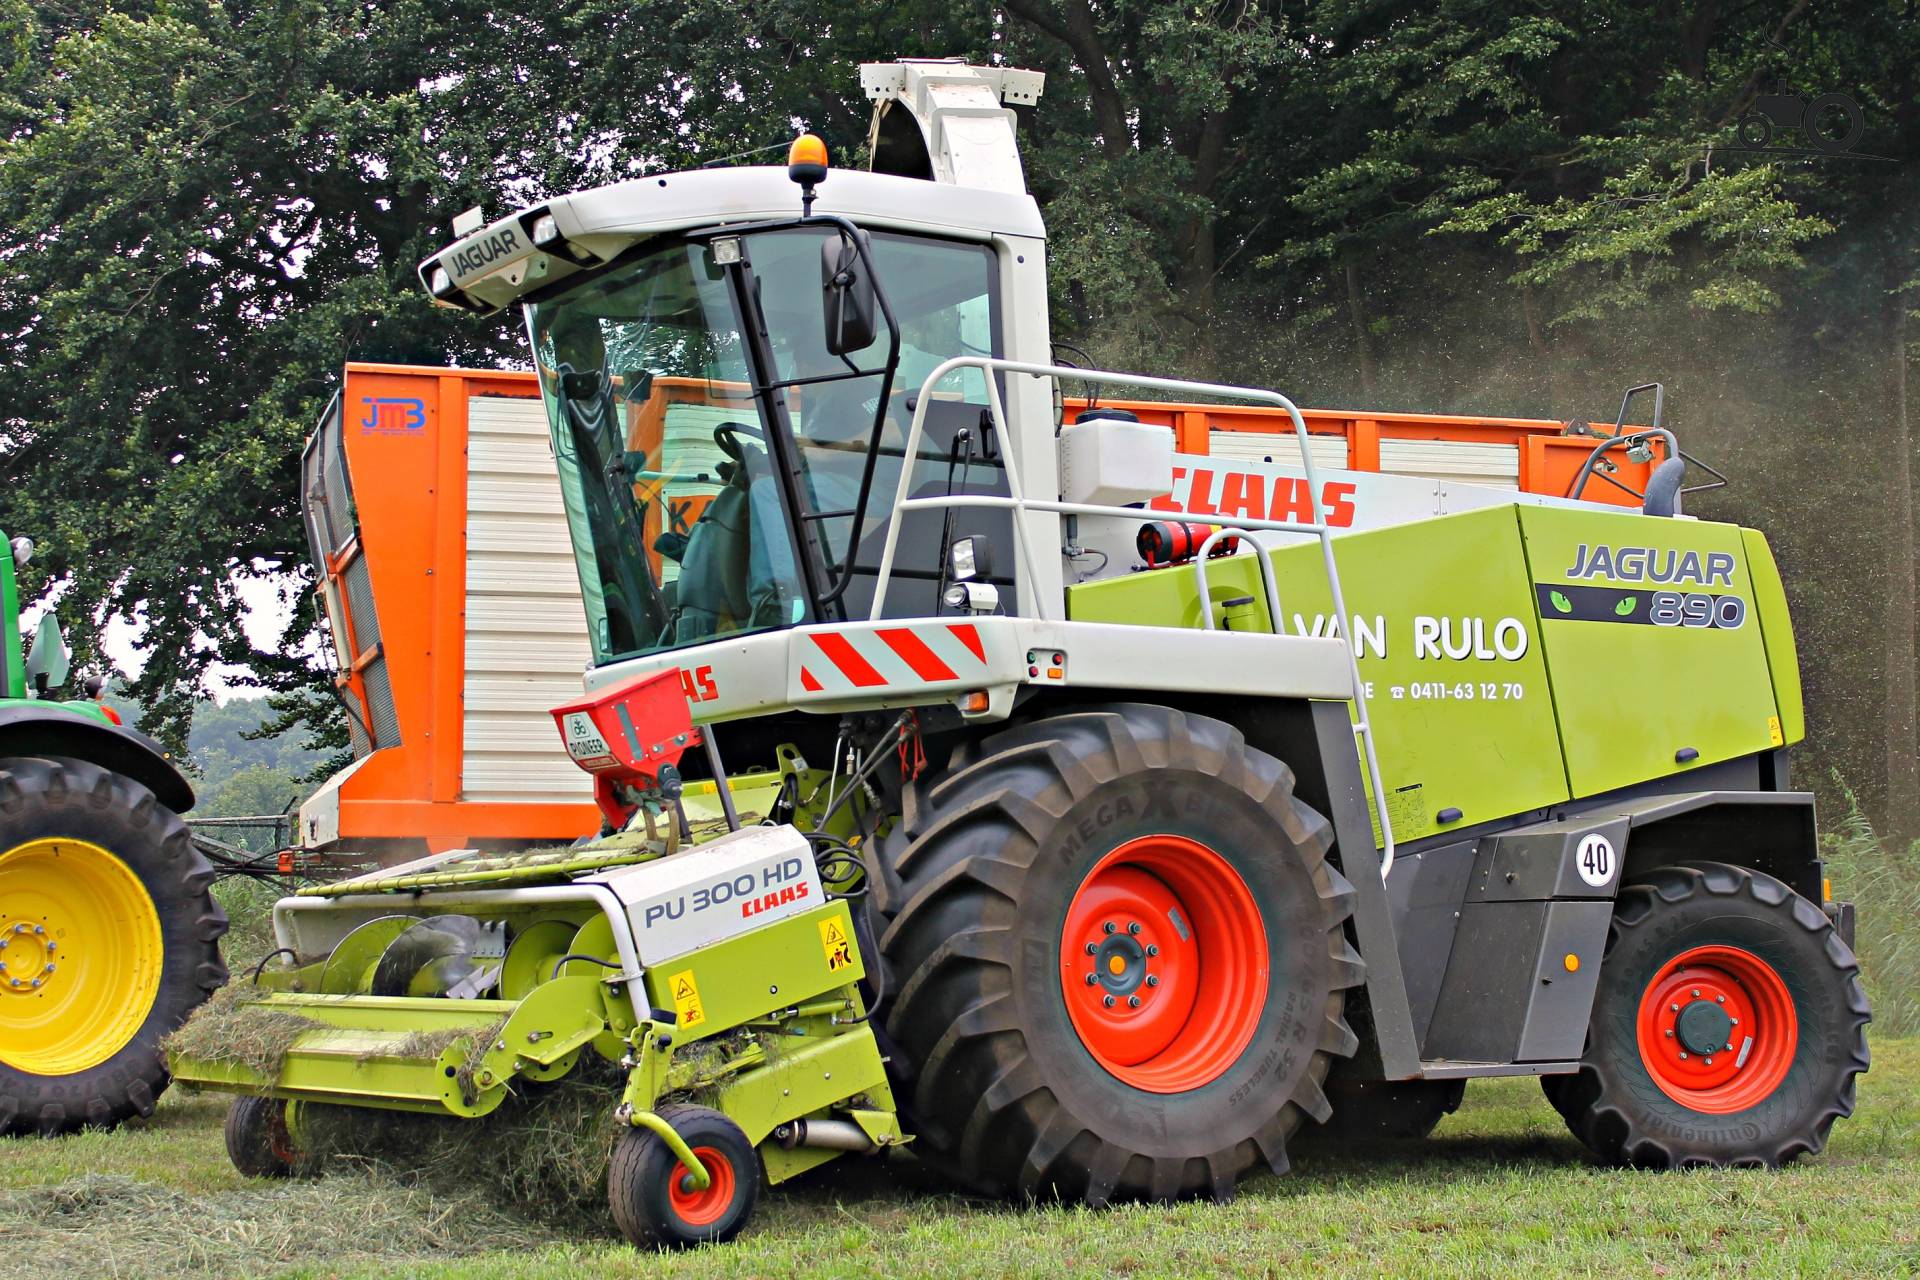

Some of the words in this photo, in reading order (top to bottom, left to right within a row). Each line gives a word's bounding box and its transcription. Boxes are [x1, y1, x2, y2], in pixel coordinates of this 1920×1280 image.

[452, 229, 520, 278] JAGUAR
[1566, 544, 1735, 588] JAGUAR
[1649, 590, 1746, 630] 890
[1414, 616, 1528, 661] RULO
[1410, 682, 1474, 700] 0411-63
[1480, 683, 1497, 700] 12
[1502, 684, 1523, 700] 70
[569, 738, 605, 756] PIONEER
[1583, 843, 1608, 876] 40
[645, 897, 686, 929] PU
[692, 874, 756, 913] 300
[762, 858, 803, 888] HD
[742, 881, 809, 918] CLAAS
